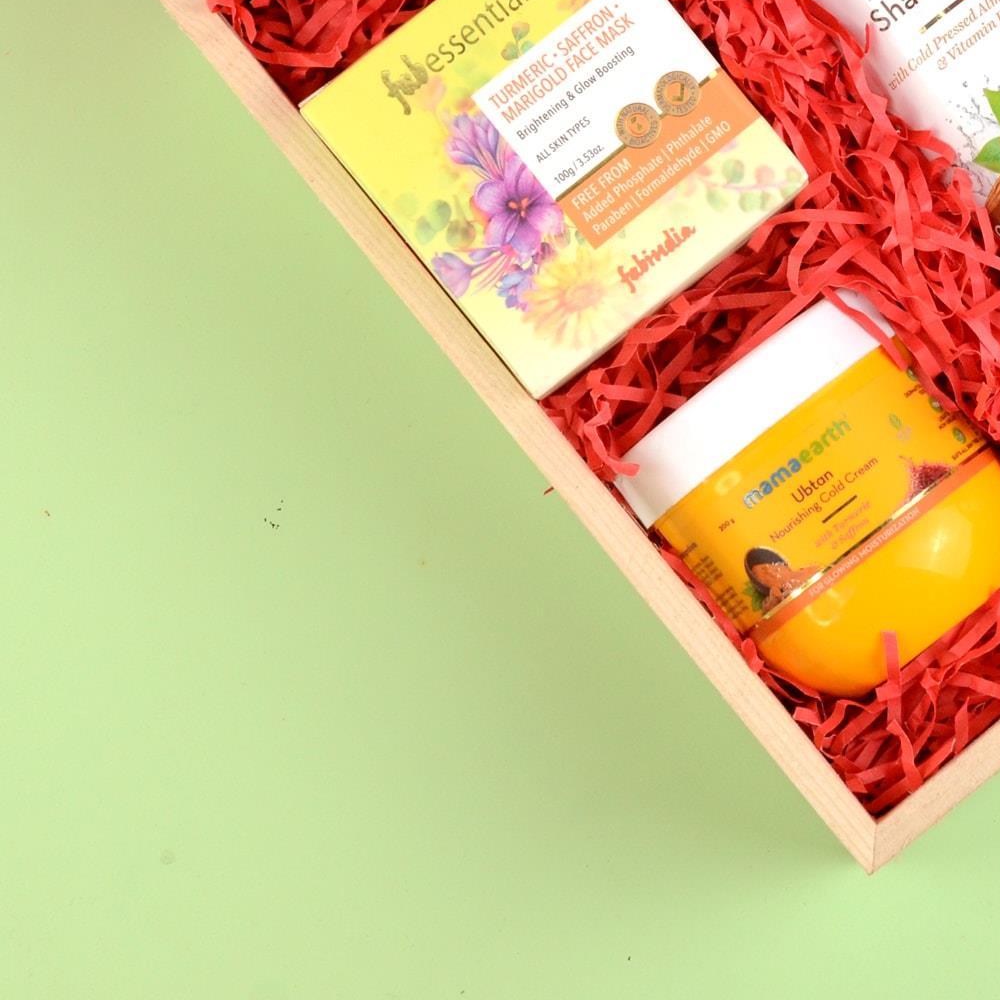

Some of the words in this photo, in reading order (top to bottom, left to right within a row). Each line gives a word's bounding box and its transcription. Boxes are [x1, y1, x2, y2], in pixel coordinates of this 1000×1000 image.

[488, 54, 555, 110] TURMERIC
[557, 6, 615, 56] SAFFRON
[501, 65, 569, 125] MARIGOLD
[566, 41, 599, 72] FACE
[597, 12, 636, 49] MASK
[889, 66, 910, 91] with
[909, 44, 936, 72] Cold
[933, 10, 978, 50] Pressed
[938, 59, 948, 70] &
[948, 20, 998, 61] Vitamin
[516, 95, 570, 141] Brightening
[567, 92, 576, 101] &
[573, 72, 599, 94] Glow
[596, 45, 636, 77] Boosting
[535, 147, 552, 164] ALL
[548, 132, 569, 153] SKIN
[567, 116, 591, 137] TYPES
[553, 165, 576, 184] 100g
[577, 144, 604, 167] 3.53oz.
[582, 196, 615, 222] Added
[613, 156, 664, 204] Phosphate
[666, 115, 713, 156] Phthalate
[591, 203, 632, 235] Paraben
[637, 148, 704, 201] Formaldehyde
[705, 120, 731, 146] GMO
[571, 180, 602, 210] FREE
[599, 159, 632, 189] FROM
[617, 225, 696, 293] fabindia
[743, 417, 852, 509] mamaearth
[770, 500, 822, 543] Nourishing
[819, 480, 845, 504] Cold
[844, 457, 879, 483] Cream
[791, 469, 834, 503] Ubtan
[718, 519, 731, 532] 200
[809, 581, 826, 596] FOR
[824, 554, 860, 586] GLOWING
[859, 508, 919, 559] MOISTURIZATION
